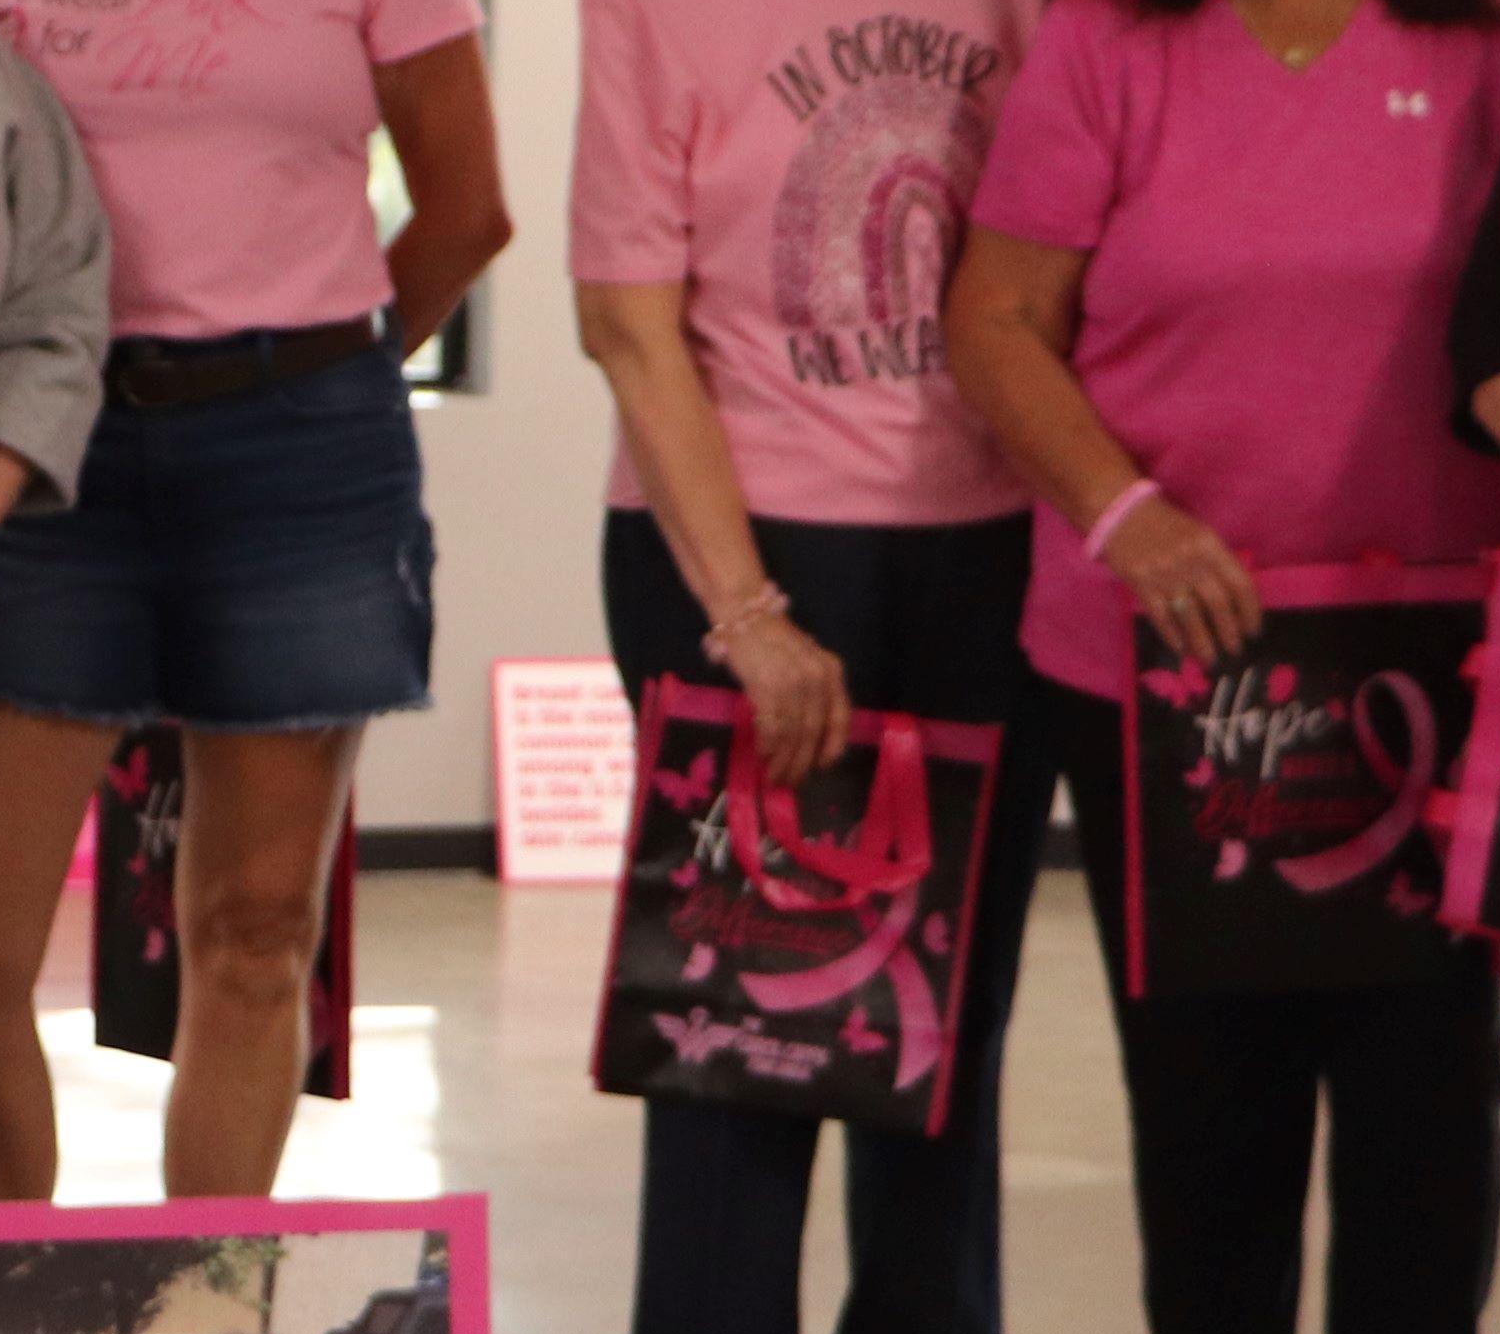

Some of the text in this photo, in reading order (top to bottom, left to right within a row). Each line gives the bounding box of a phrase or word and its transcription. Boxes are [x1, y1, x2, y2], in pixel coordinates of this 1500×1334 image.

[38, 19, 94, 56] for
[766, 14, 1003, 124] IN OCTOBER
[858, 314, 949, 381] WEA
[1194, 666, 1334, 781] Hope
